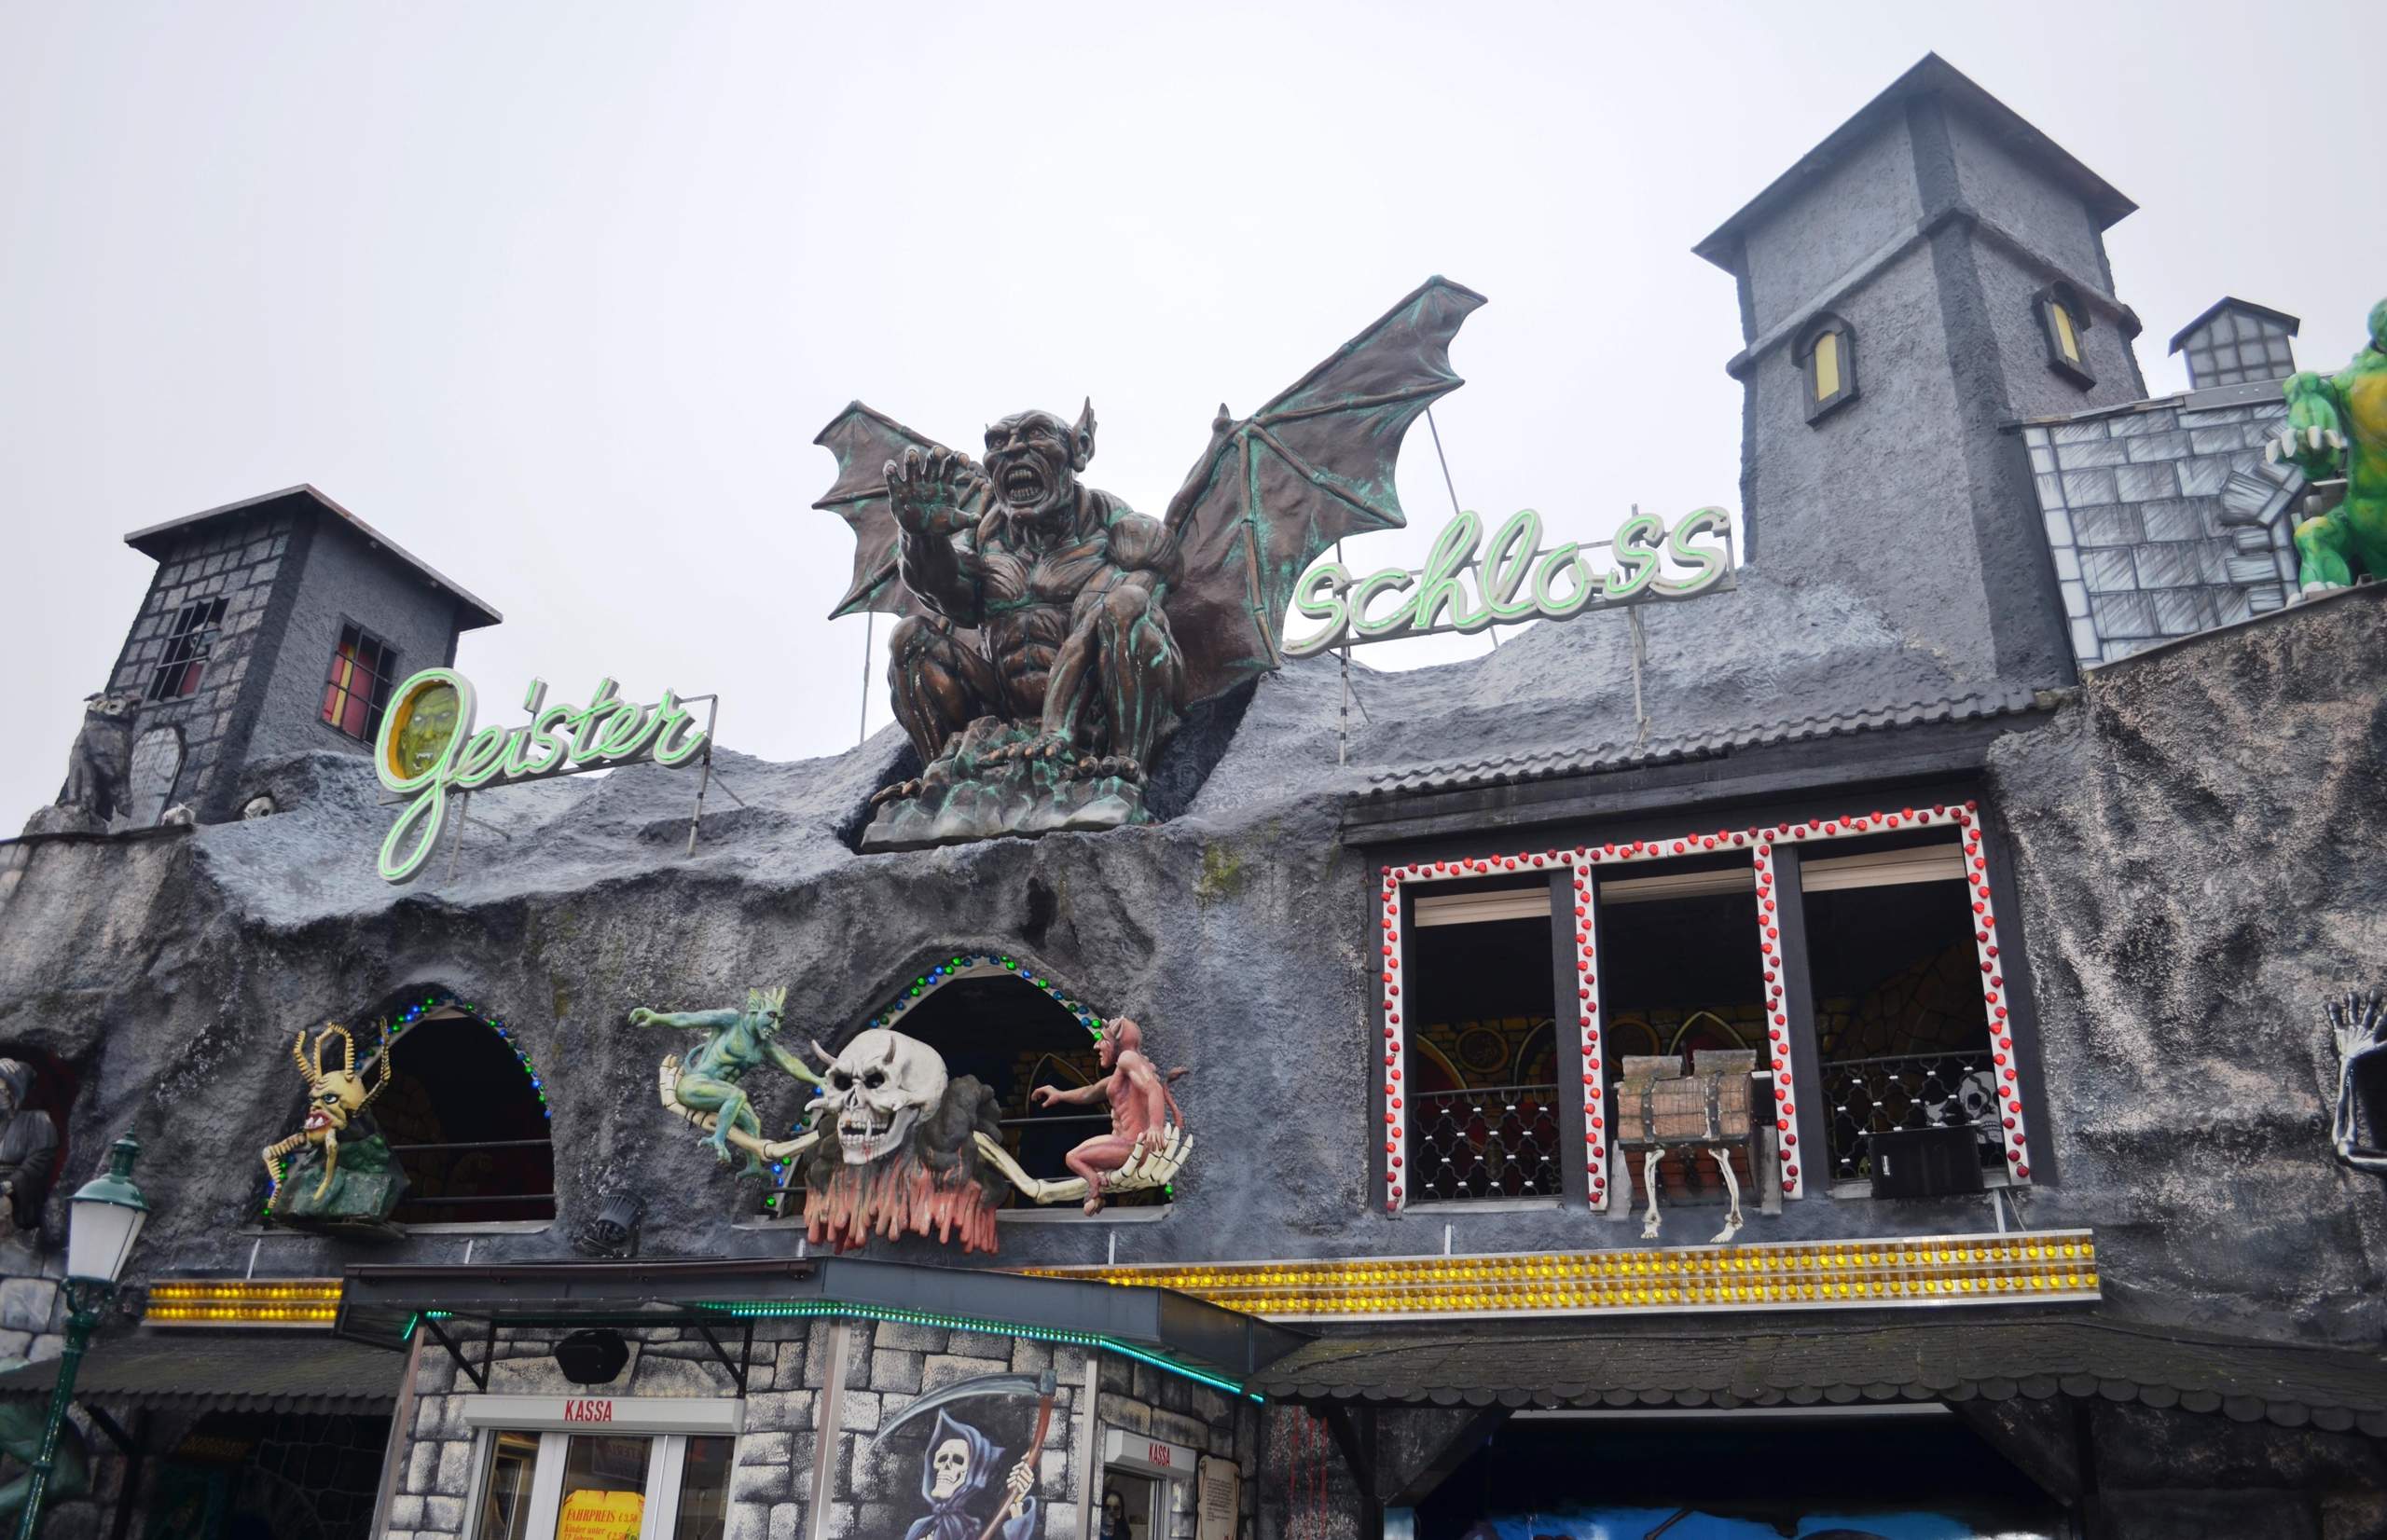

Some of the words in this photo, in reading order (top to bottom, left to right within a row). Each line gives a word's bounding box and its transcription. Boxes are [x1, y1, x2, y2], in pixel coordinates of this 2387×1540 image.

[375, 667, 714, 886] Geister
[564, 1399, 613, 1423] KASSA
[1149, 1443, 1170, 1467] KASSA
[566, 1508, 615, 1522] FAHRPREIS
